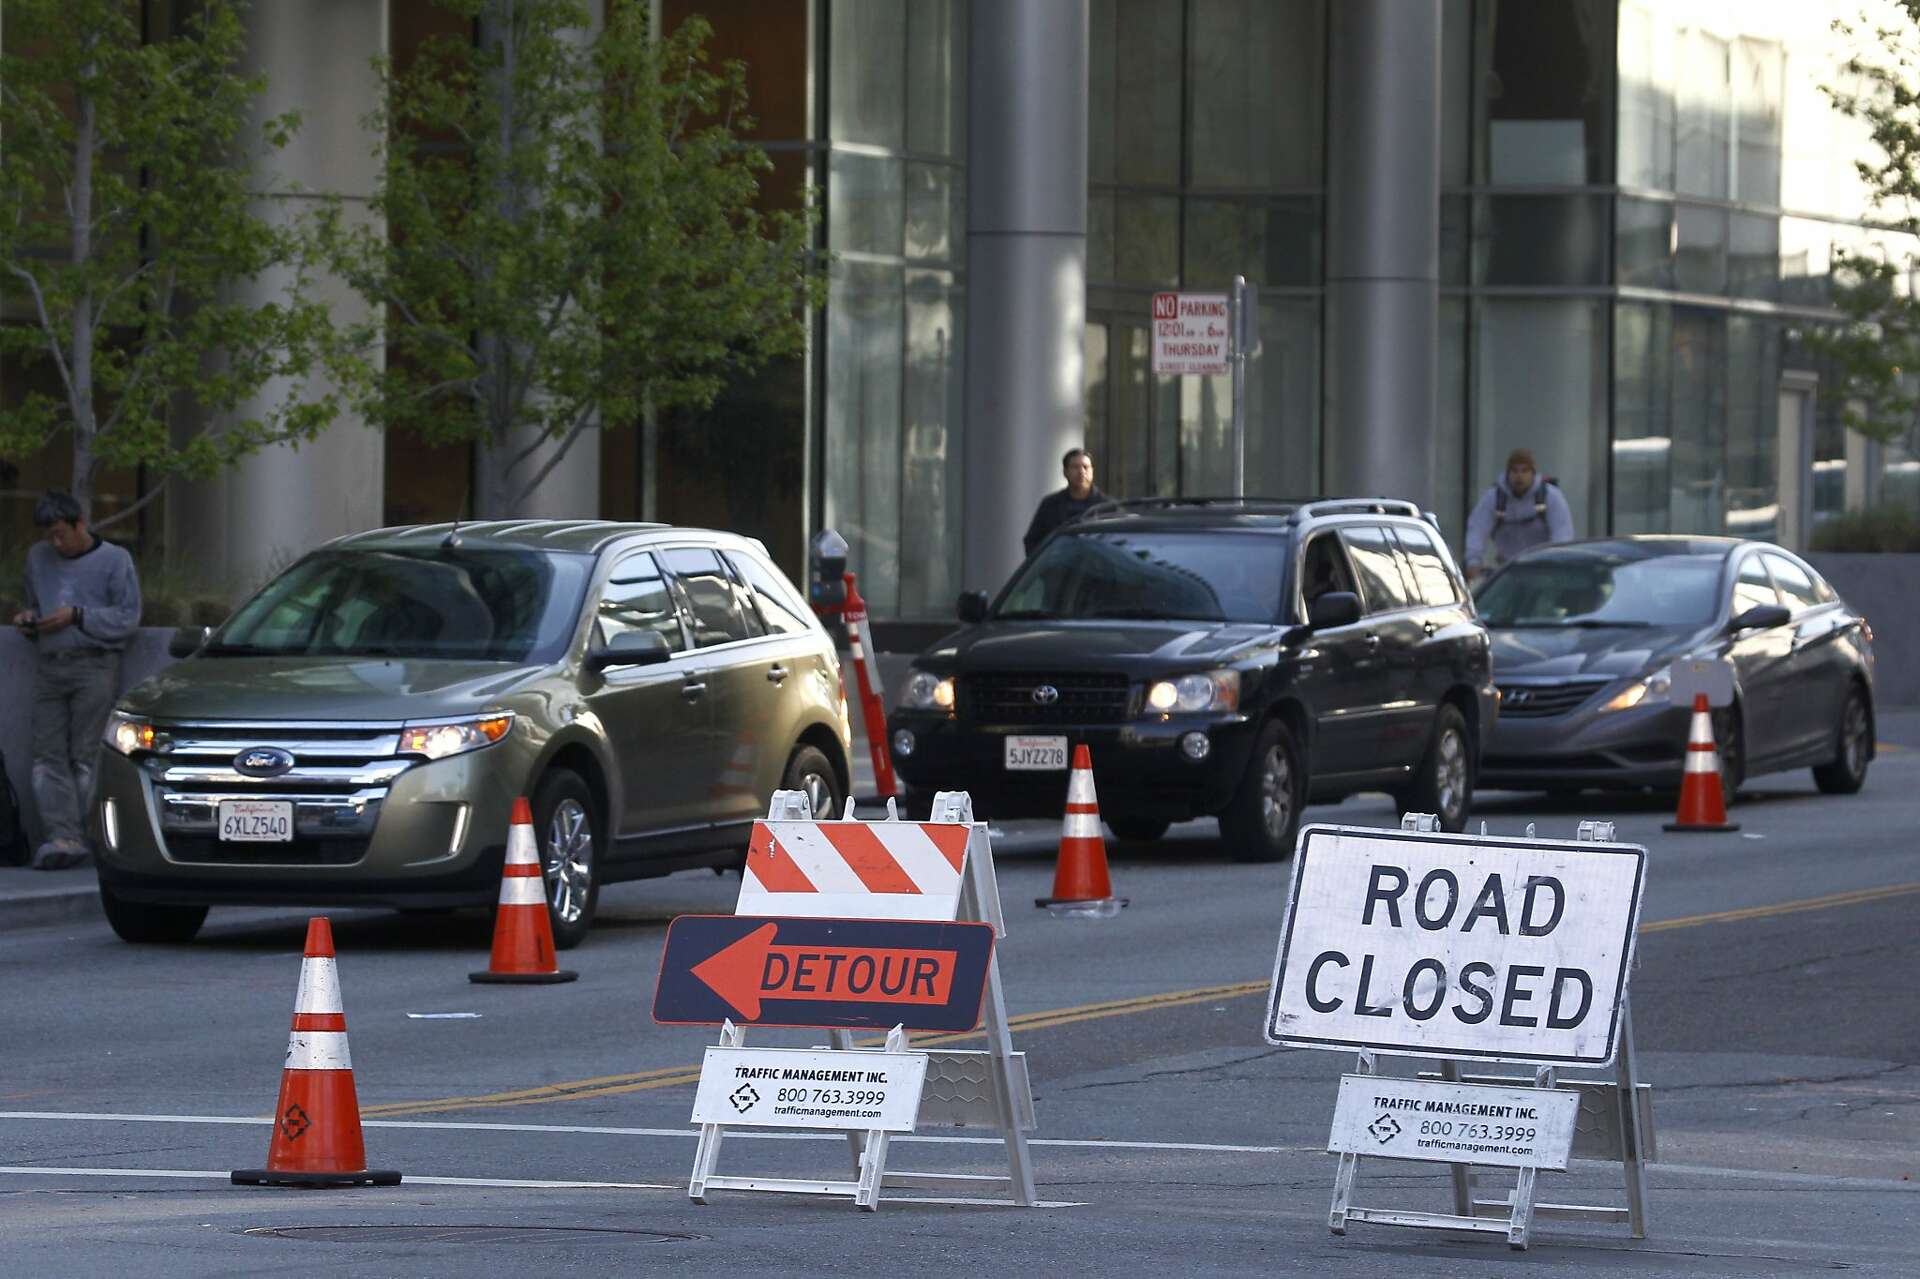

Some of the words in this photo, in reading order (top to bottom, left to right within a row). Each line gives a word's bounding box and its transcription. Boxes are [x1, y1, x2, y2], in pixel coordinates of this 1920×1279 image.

[1156, 295, 1176, 317] NO
[1180, 302, 1227, 317] PARKING
[1163, 342, 1219, 356] THURSDAY
[1010, 747, 1064, 765] 5JYZ278
[224, 815, 287, 835] 6XLZ540
[1361, 864, 1566, 937] ROAD
[760, 952, 940, 997] DETOUR
[1305, 950, 1594, 1030] CLOSED
[735, 1067, 779, 1080] TRAFFIC
[782, 1068, 865, 1082] MANAGEMENT
[866, 1071, 888, 1084] INC.
[777, 1088, 807, 1103] 800
[812, 1089, 886, 1106] 763.3999
[774, 1106, 882, 1119] trafficmanagement.com
[1374, 1096, 1421, 1111] TRAFFIC
[1424, 1101, 1513, 1118] MANAGEMENT
[1515, 1107, 1539, 1120] INC.
[1420, 1120, 1452, 1136] 800
[1458, 1123, 1537, 1142] 763.3999
[1417, 1138, 1533, 1155] trafficmanagement.com
